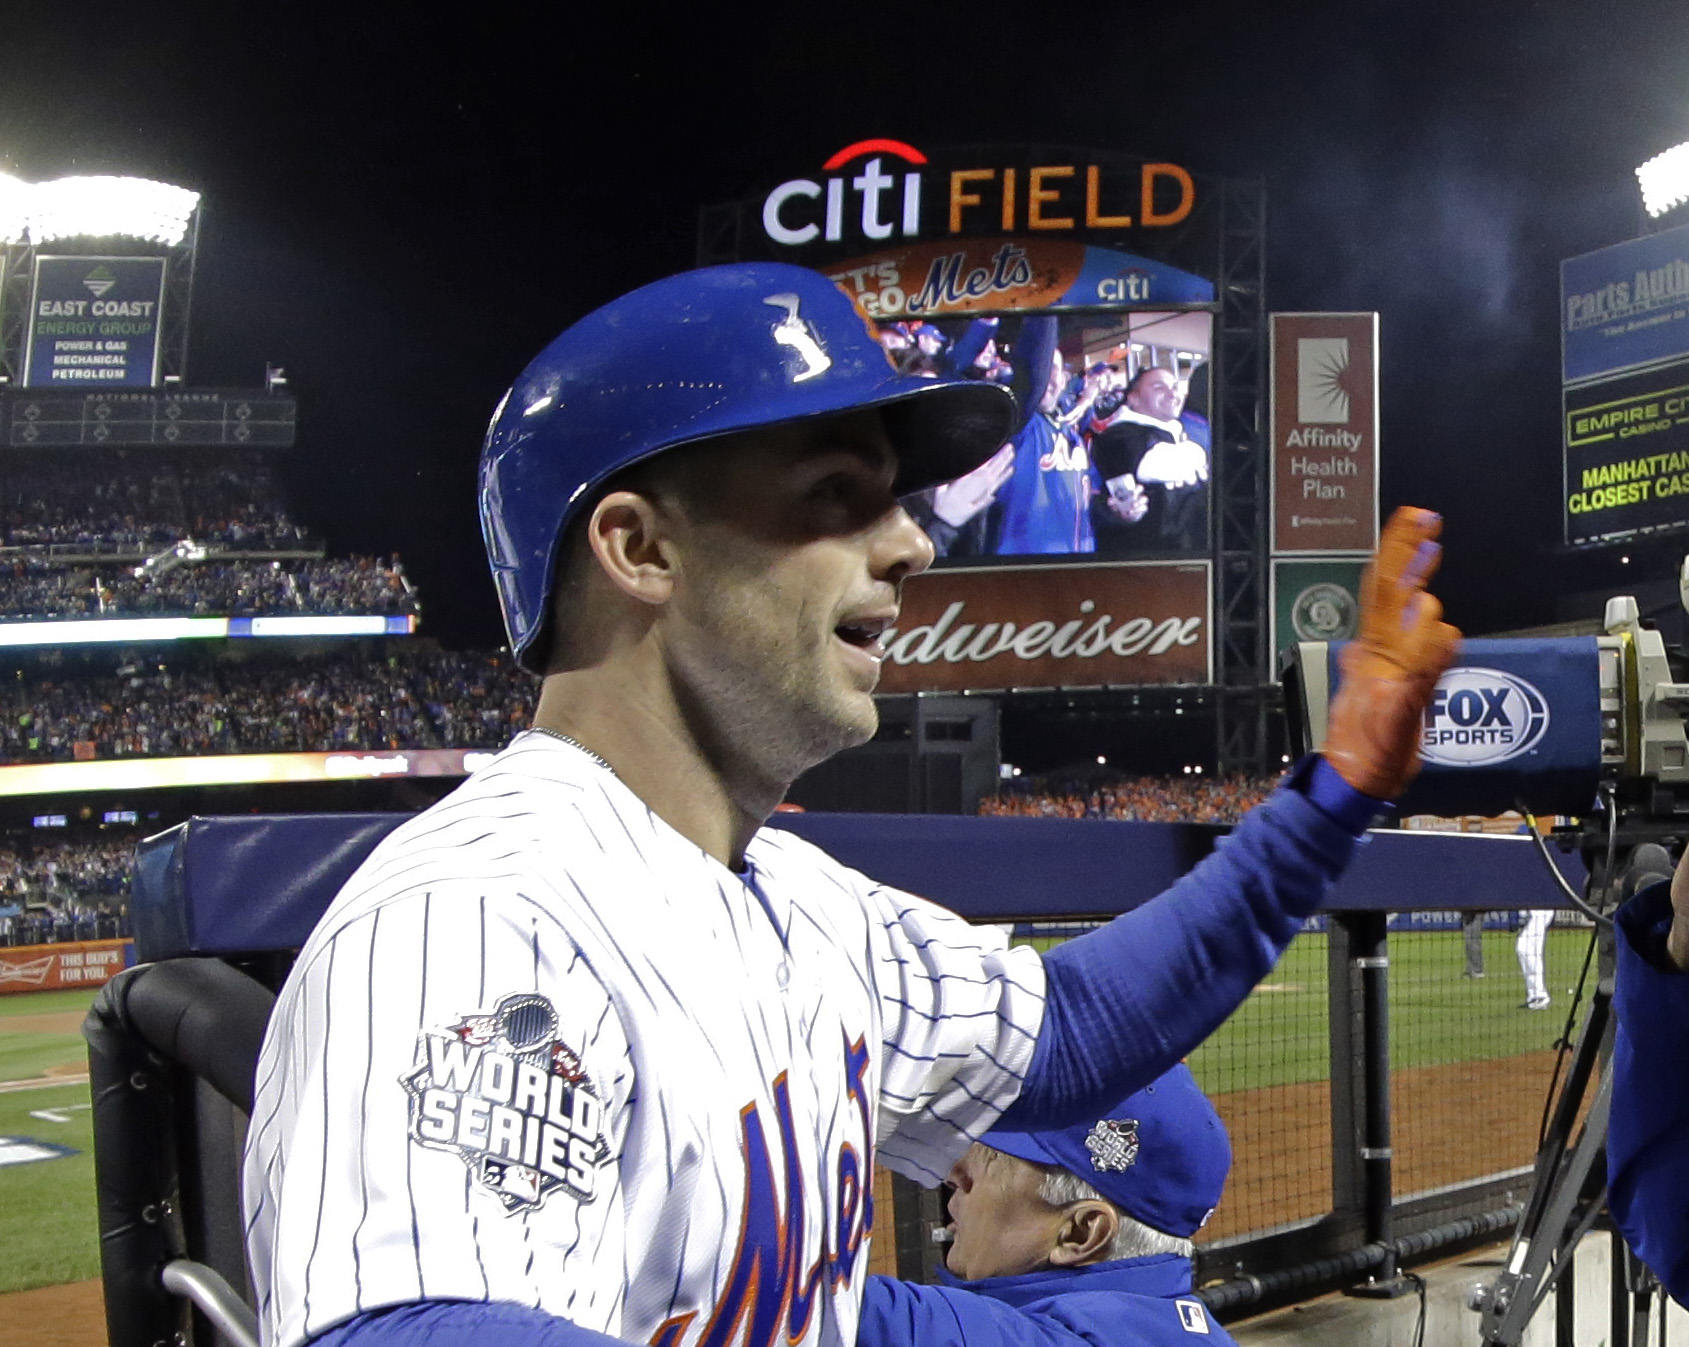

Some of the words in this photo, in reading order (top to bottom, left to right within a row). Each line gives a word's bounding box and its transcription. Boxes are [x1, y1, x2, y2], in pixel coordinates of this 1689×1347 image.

[762, 157, 922, 246] citi
[949, 162, 1196, 235] FIELD
[858, 286, 905, 318] GO
[907, 243, 1033, 314] Mets
[39, 301, 86, 317] EAST
[92, 300, 154, 317] COAST
[1567, 280, 1631, 332] Parts
[37, 321, 97, 336] ENERGY
[100, 320, 152, 335] GROUP
[55, 340, 93, 351] POWER
[105, 340, 127, 351] GAS
[54, 354, 126, 366] MECHANICAL
[52, 369, 125, 380] PETROLEUM
[1576, 403, 1659, 435] EMPIRE
[1619, 418, 1672, 439] CASINO
[1286, 428, 1362, 454] Affinity
[1291, 456, 1358, 478] Health
[1303, 479, 1345, 500] Plan
[1569, 480, 1653, 515] CLOSEST
[1424, 688, 1512, 729] FOX
[1424, 728, 1514, 746] SPORTS
[425, 1034, 601, 1140] WORLD
[420, 1088, 598, 1199] SERIES
